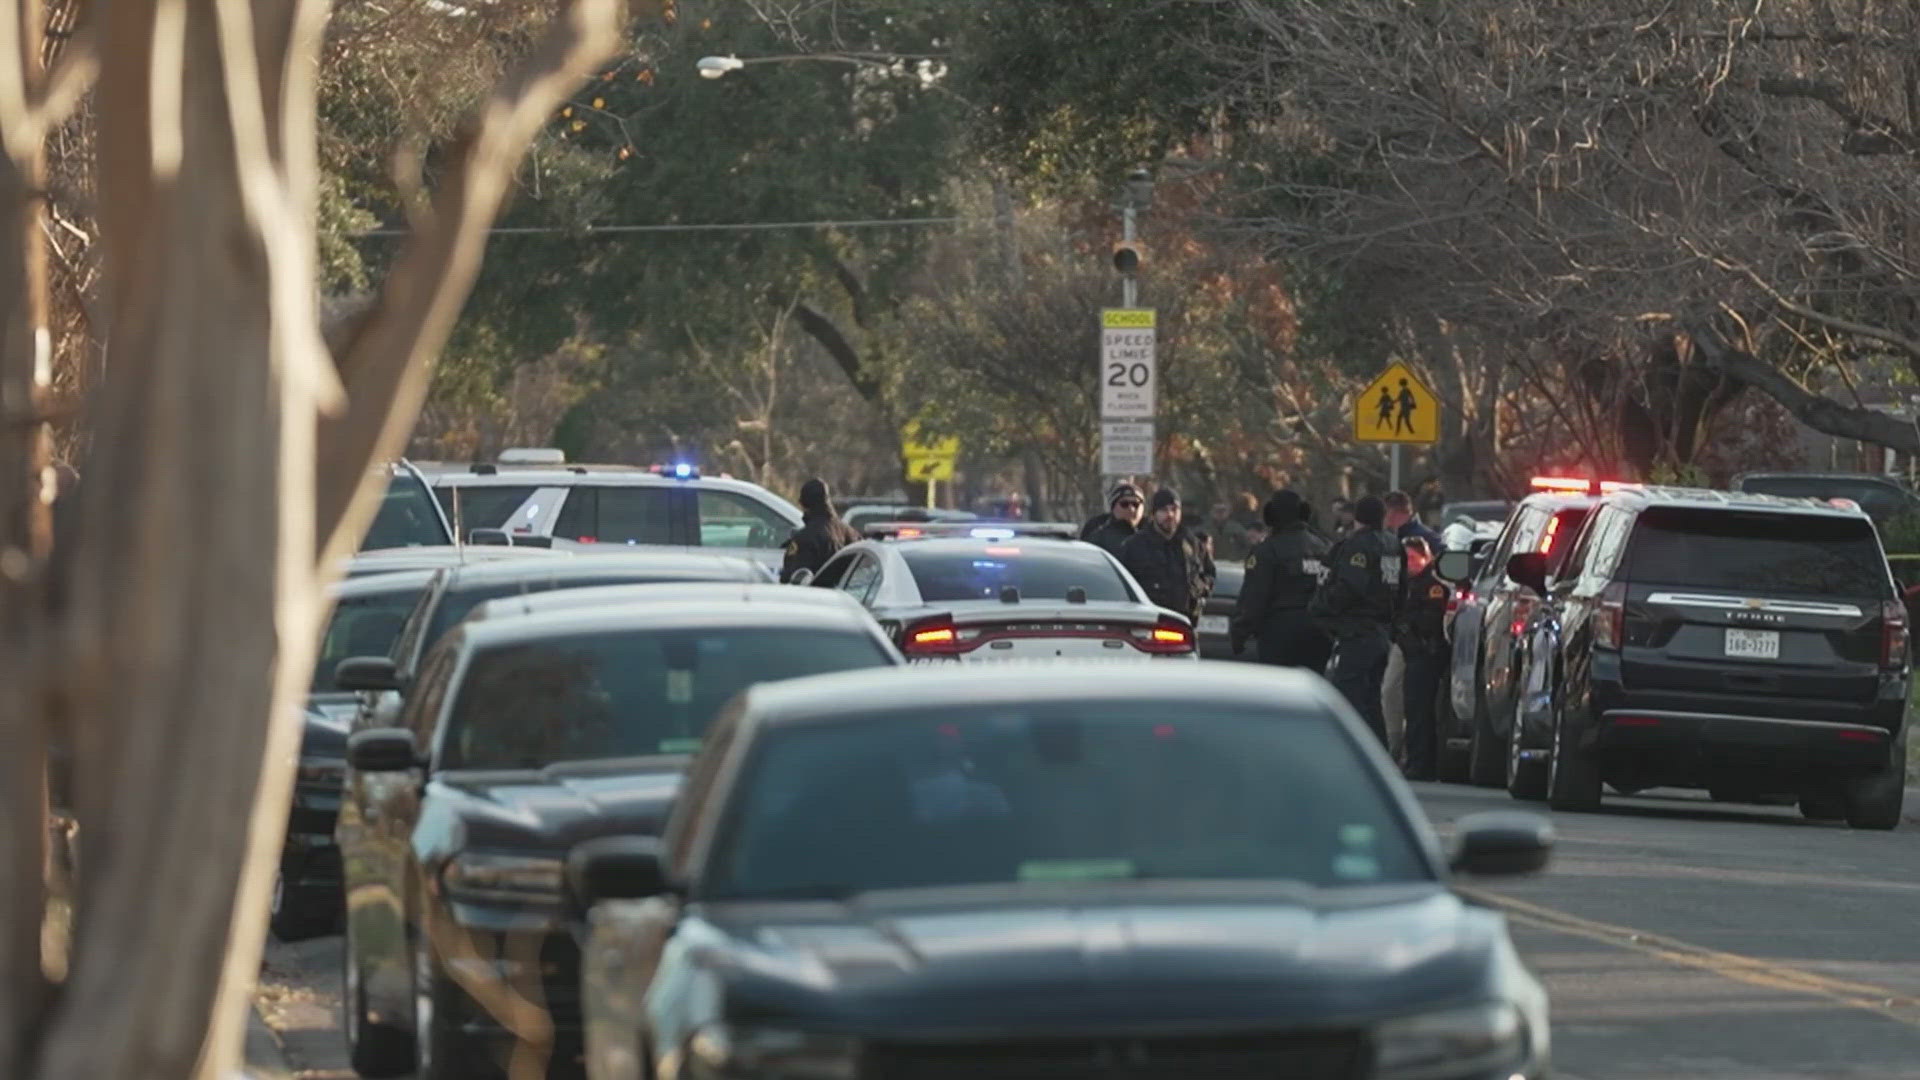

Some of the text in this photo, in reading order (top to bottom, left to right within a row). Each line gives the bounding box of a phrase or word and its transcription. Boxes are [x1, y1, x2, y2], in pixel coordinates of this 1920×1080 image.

[1105, 312, 1152, 325] SCHOOL
[1105, 334, 1153, 346] SPEED
[1110, 349, 1150, 359] LIMIT
[1108, 362, 1149, 388] 20
[1726, 612, 1785, 622] TAHOE
